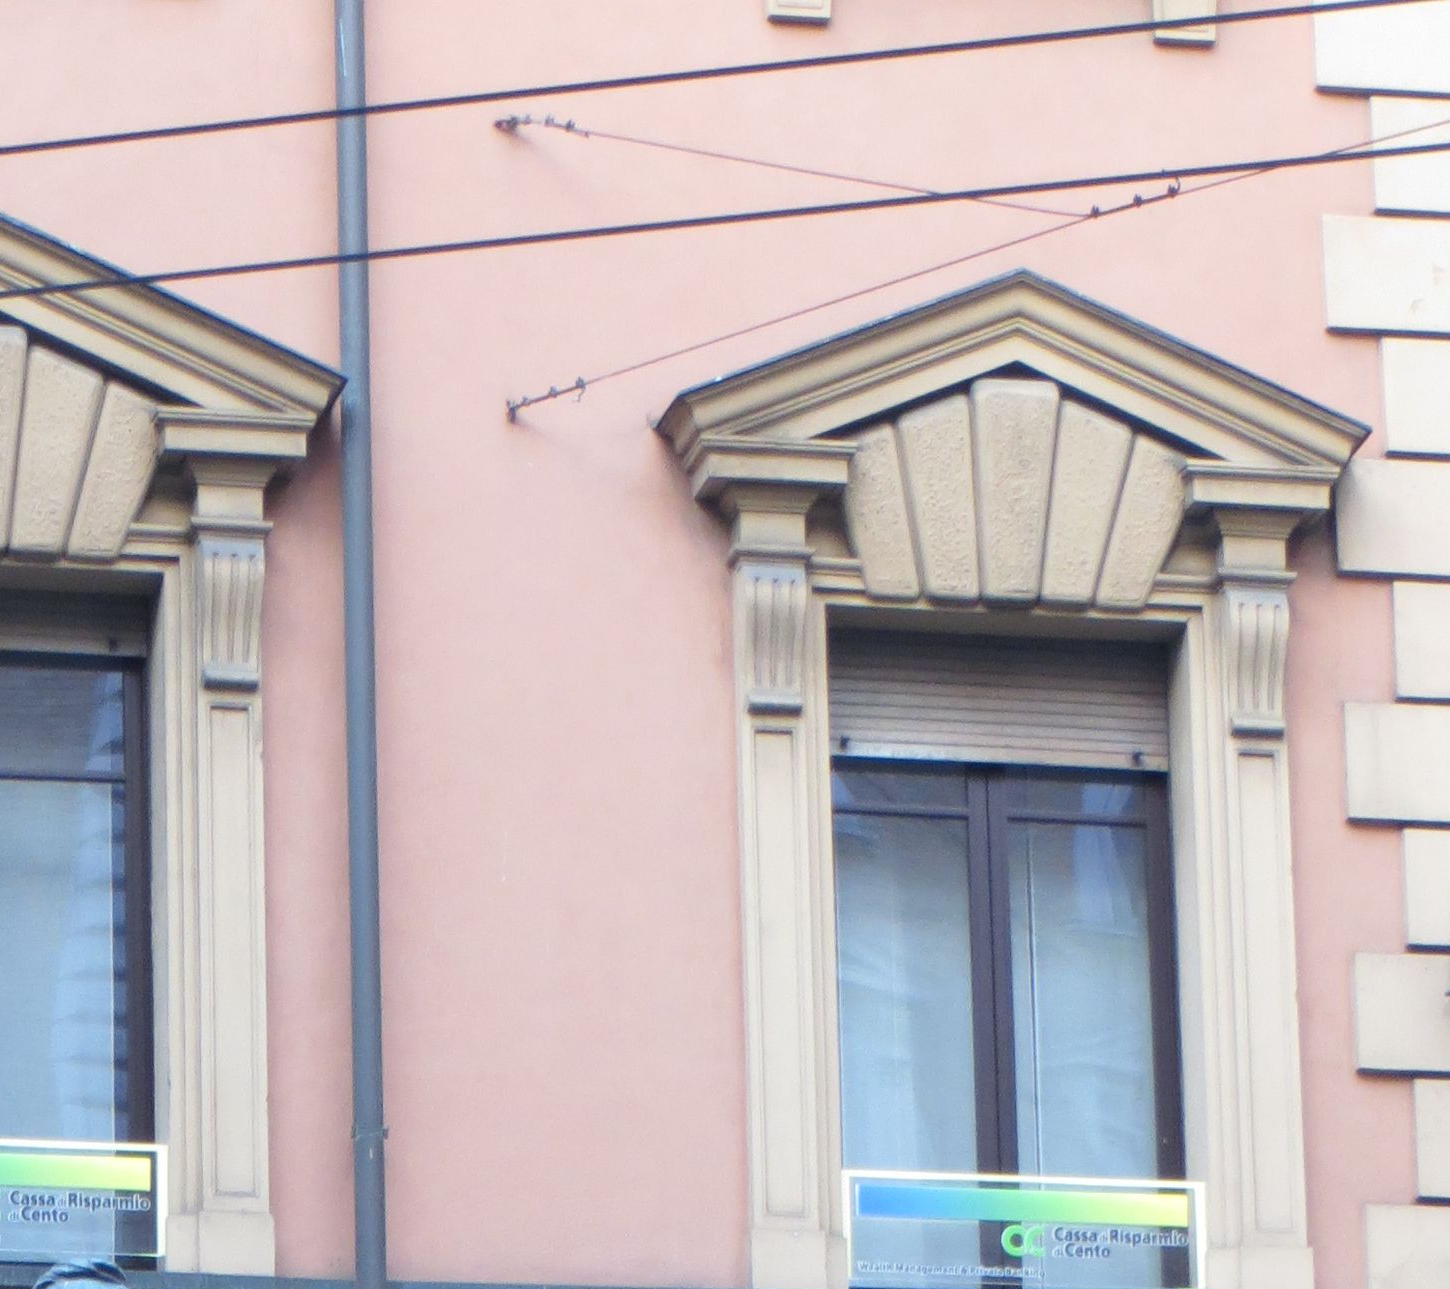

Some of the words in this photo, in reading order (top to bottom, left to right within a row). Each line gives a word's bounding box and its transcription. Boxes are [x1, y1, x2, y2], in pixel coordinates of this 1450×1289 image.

[9, 1190, 56, 1207] Cassa
[67, 1192, 151, 1212] Risparmio
[21, 1206, 69, 1223] Cento
[1053, 1226, 1098, 1243] Cassa
[1108, 1228, 1189, 1247] Risparmio
[1065, 1243, 1112, 1259] Cento
